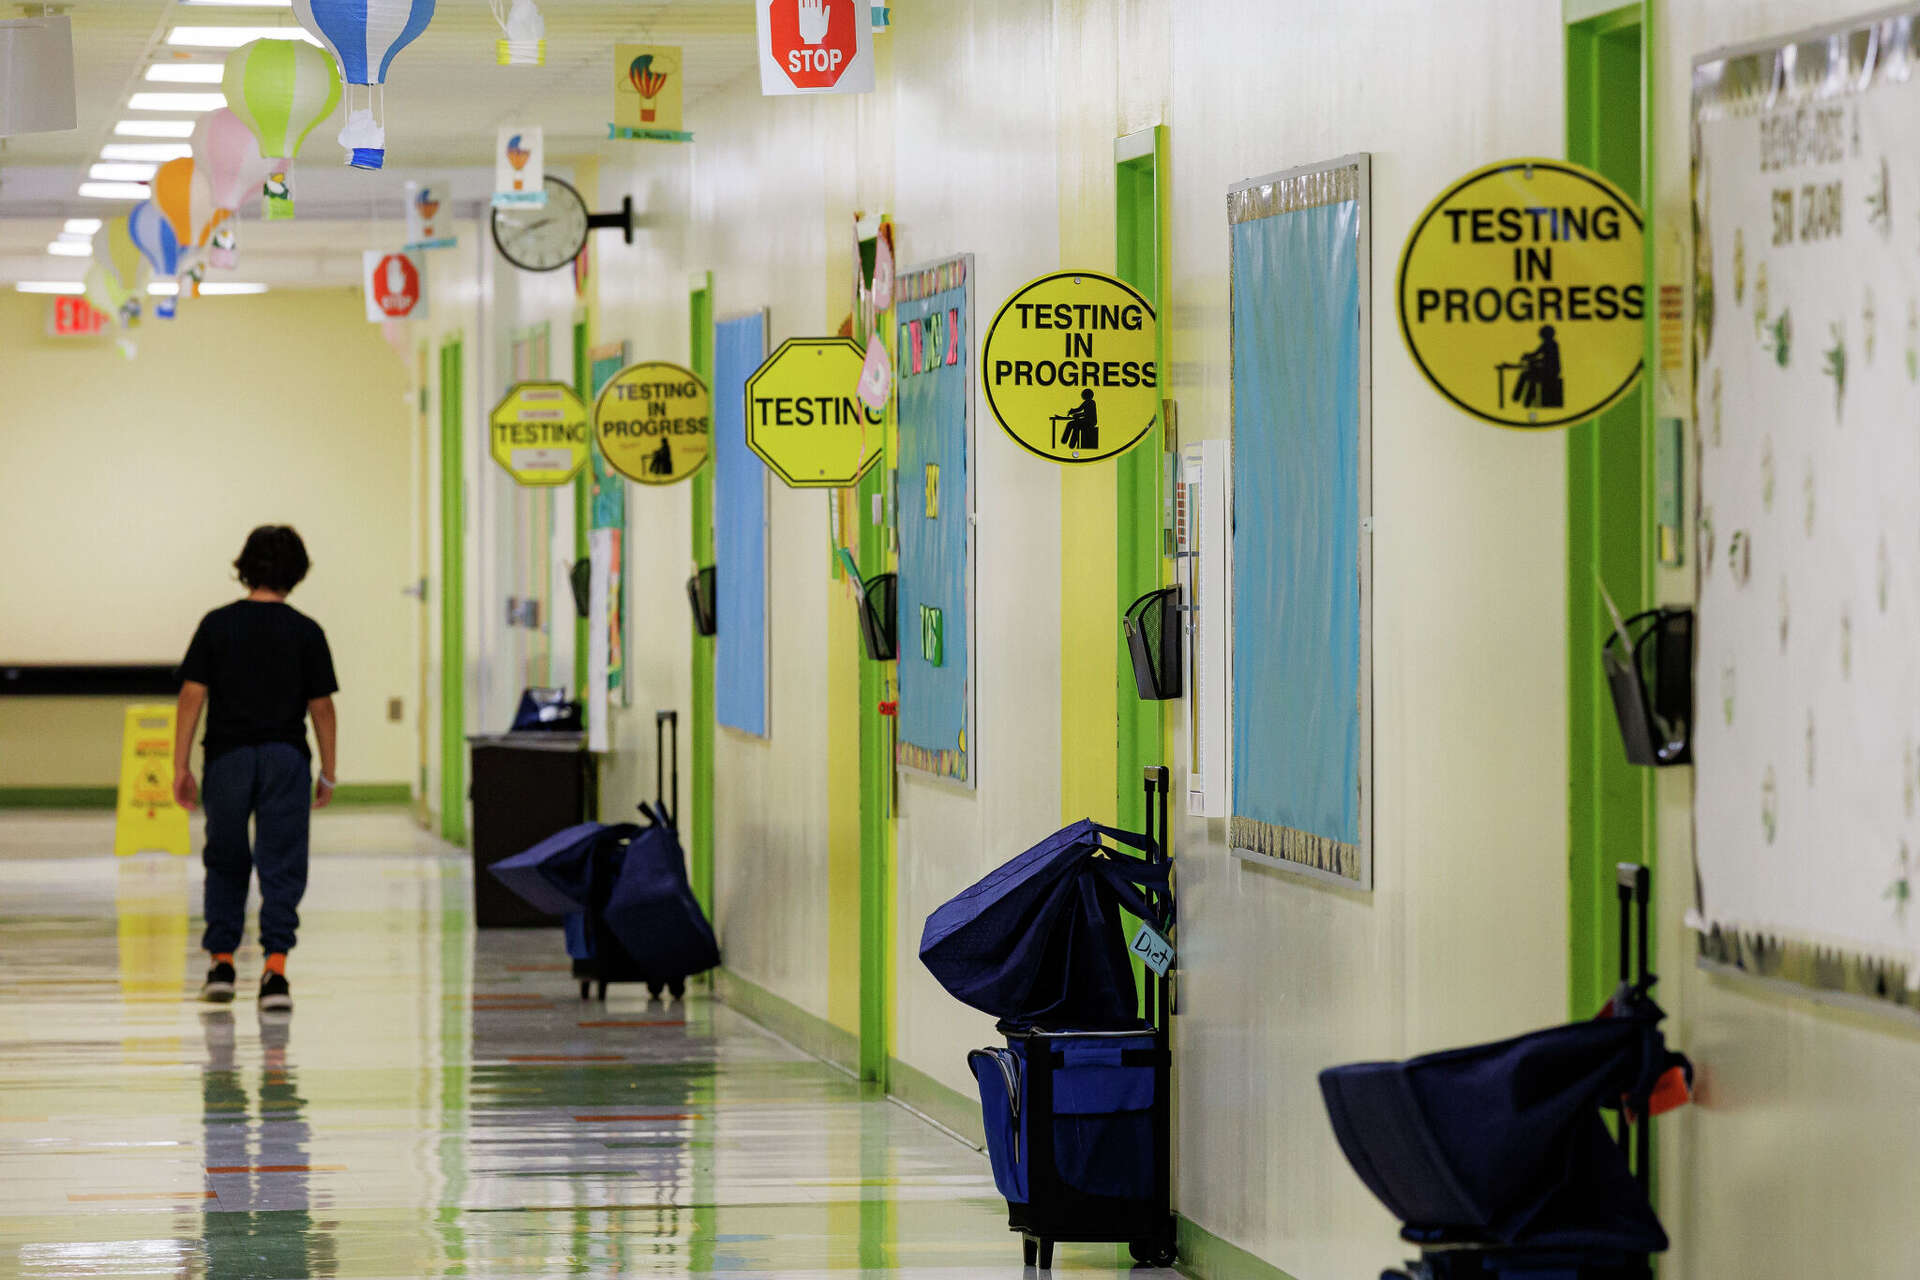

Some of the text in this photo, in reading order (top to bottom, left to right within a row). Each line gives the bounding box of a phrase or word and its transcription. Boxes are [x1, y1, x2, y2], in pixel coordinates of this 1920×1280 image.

[788, 48, 843, 73] STOP
[1444, 206, 1621, 243] TESTING
[1513, 247, 1553, 282] IN
[1015, 303, 1143, 331] TESTING
[1417, 284, 1644, 323] PROGRESS
[1065, 333, 1093, 358] IN
[995, 360, 1158, 388] PROGRESS
[616, 382, 697, 400] TESTING
[647, 402, 666, 417] IN
[603, 417, 709, 437] PROGRESS
[1134, 930, 1169, 967] Diet
